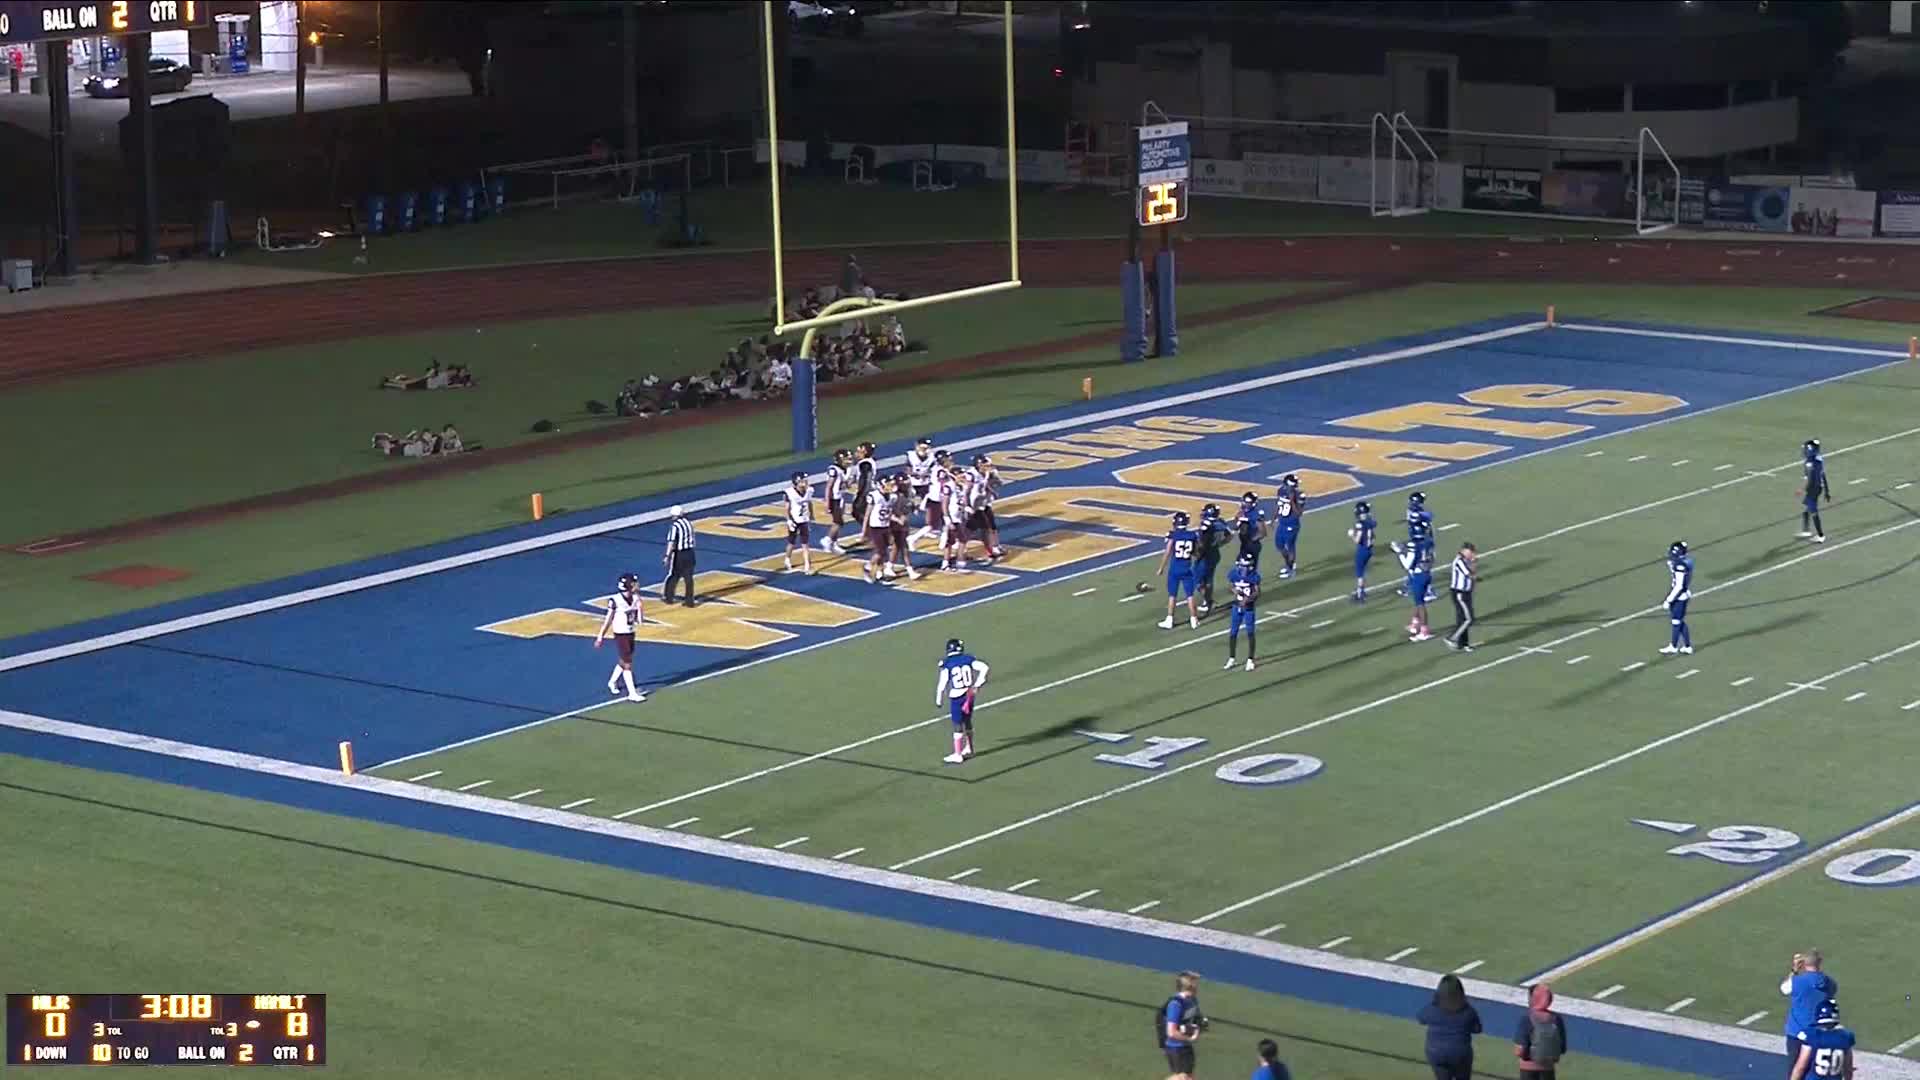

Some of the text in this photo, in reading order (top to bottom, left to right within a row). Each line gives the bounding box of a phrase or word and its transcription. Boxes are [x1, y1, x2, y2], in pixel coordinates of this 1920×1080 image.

[42, 9, 75, 31] BALL
[79, 6, 97, 28] ON
[112, 1, 128, 28] 2
[150, 1, 177, 22] QTR
[187, 1, 195, 22] 1
[1147, 183, 1177, 222] 25
[1175, 541, 1192, 559] 52
[952, 665, 972, 689] 20
[1815, 1047, 1844, 1076] 50
